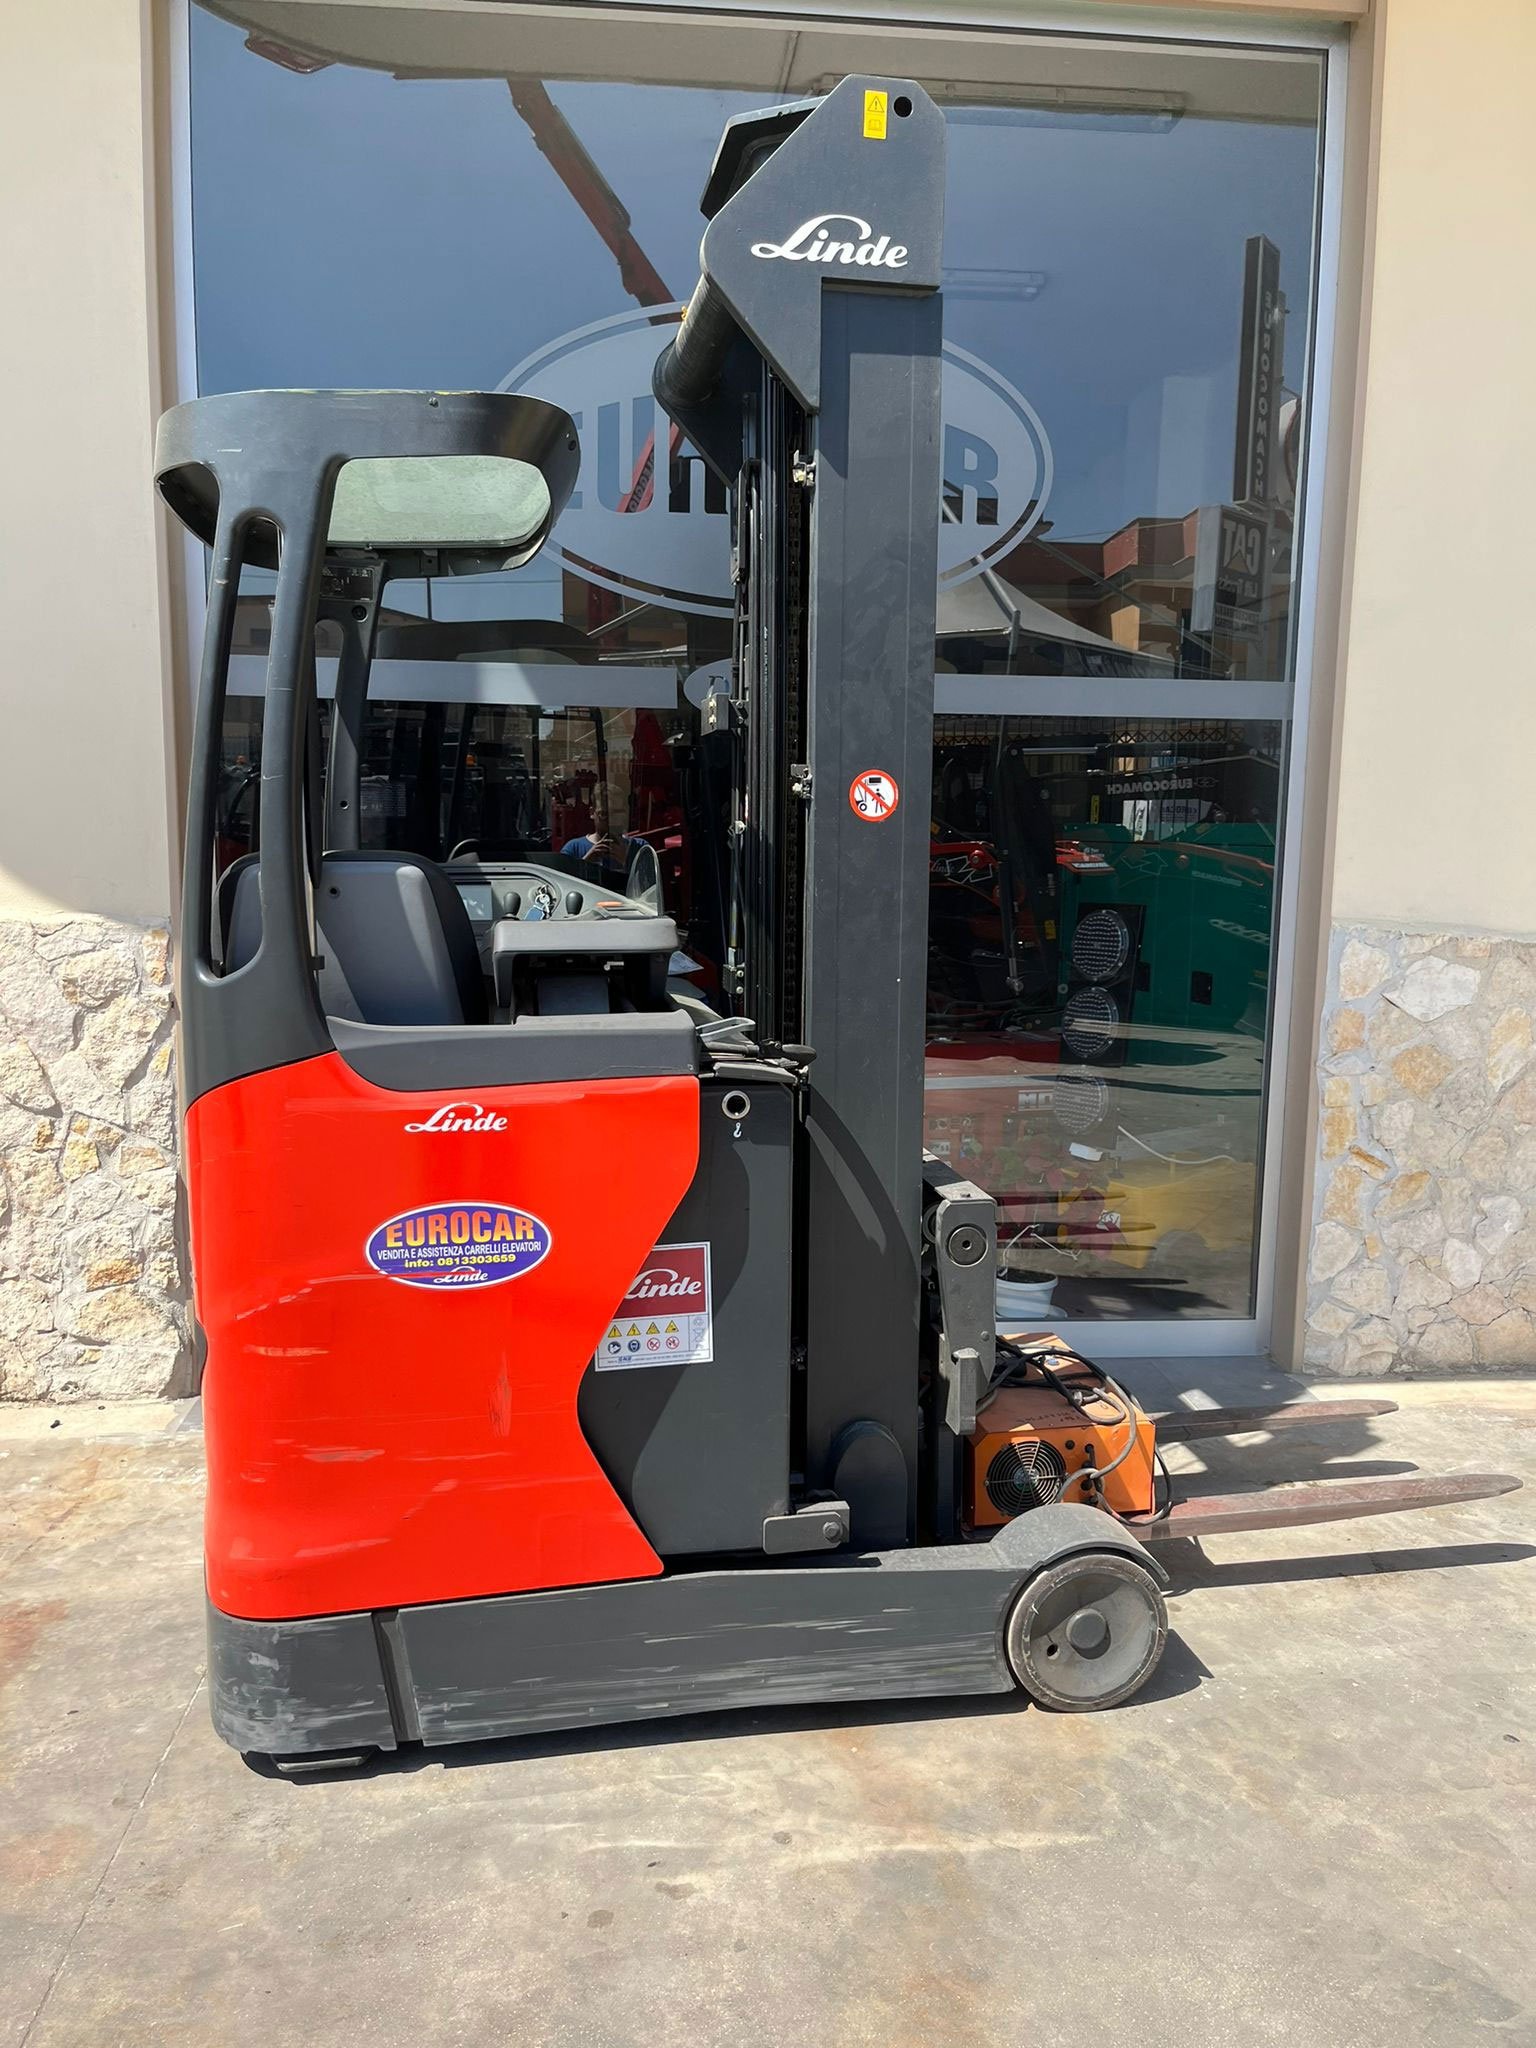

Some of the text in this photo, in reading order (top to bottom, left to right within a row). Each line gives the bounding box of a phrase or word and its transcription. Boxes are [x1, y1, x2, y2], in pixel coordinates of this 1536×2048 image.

[751, 214, 908, 268] Linde
[404, 1102, 508, 1133] Linde
[386, 1211, 535, 1248] EUROCAR
[377, 1241, 541, 1260] VENDITA E ASSISTENZA CARRELLI ELEVATORI
[404, 1254, 516, 1268] info: 0813303659
[623, 1269, 702, 1300] Linde
